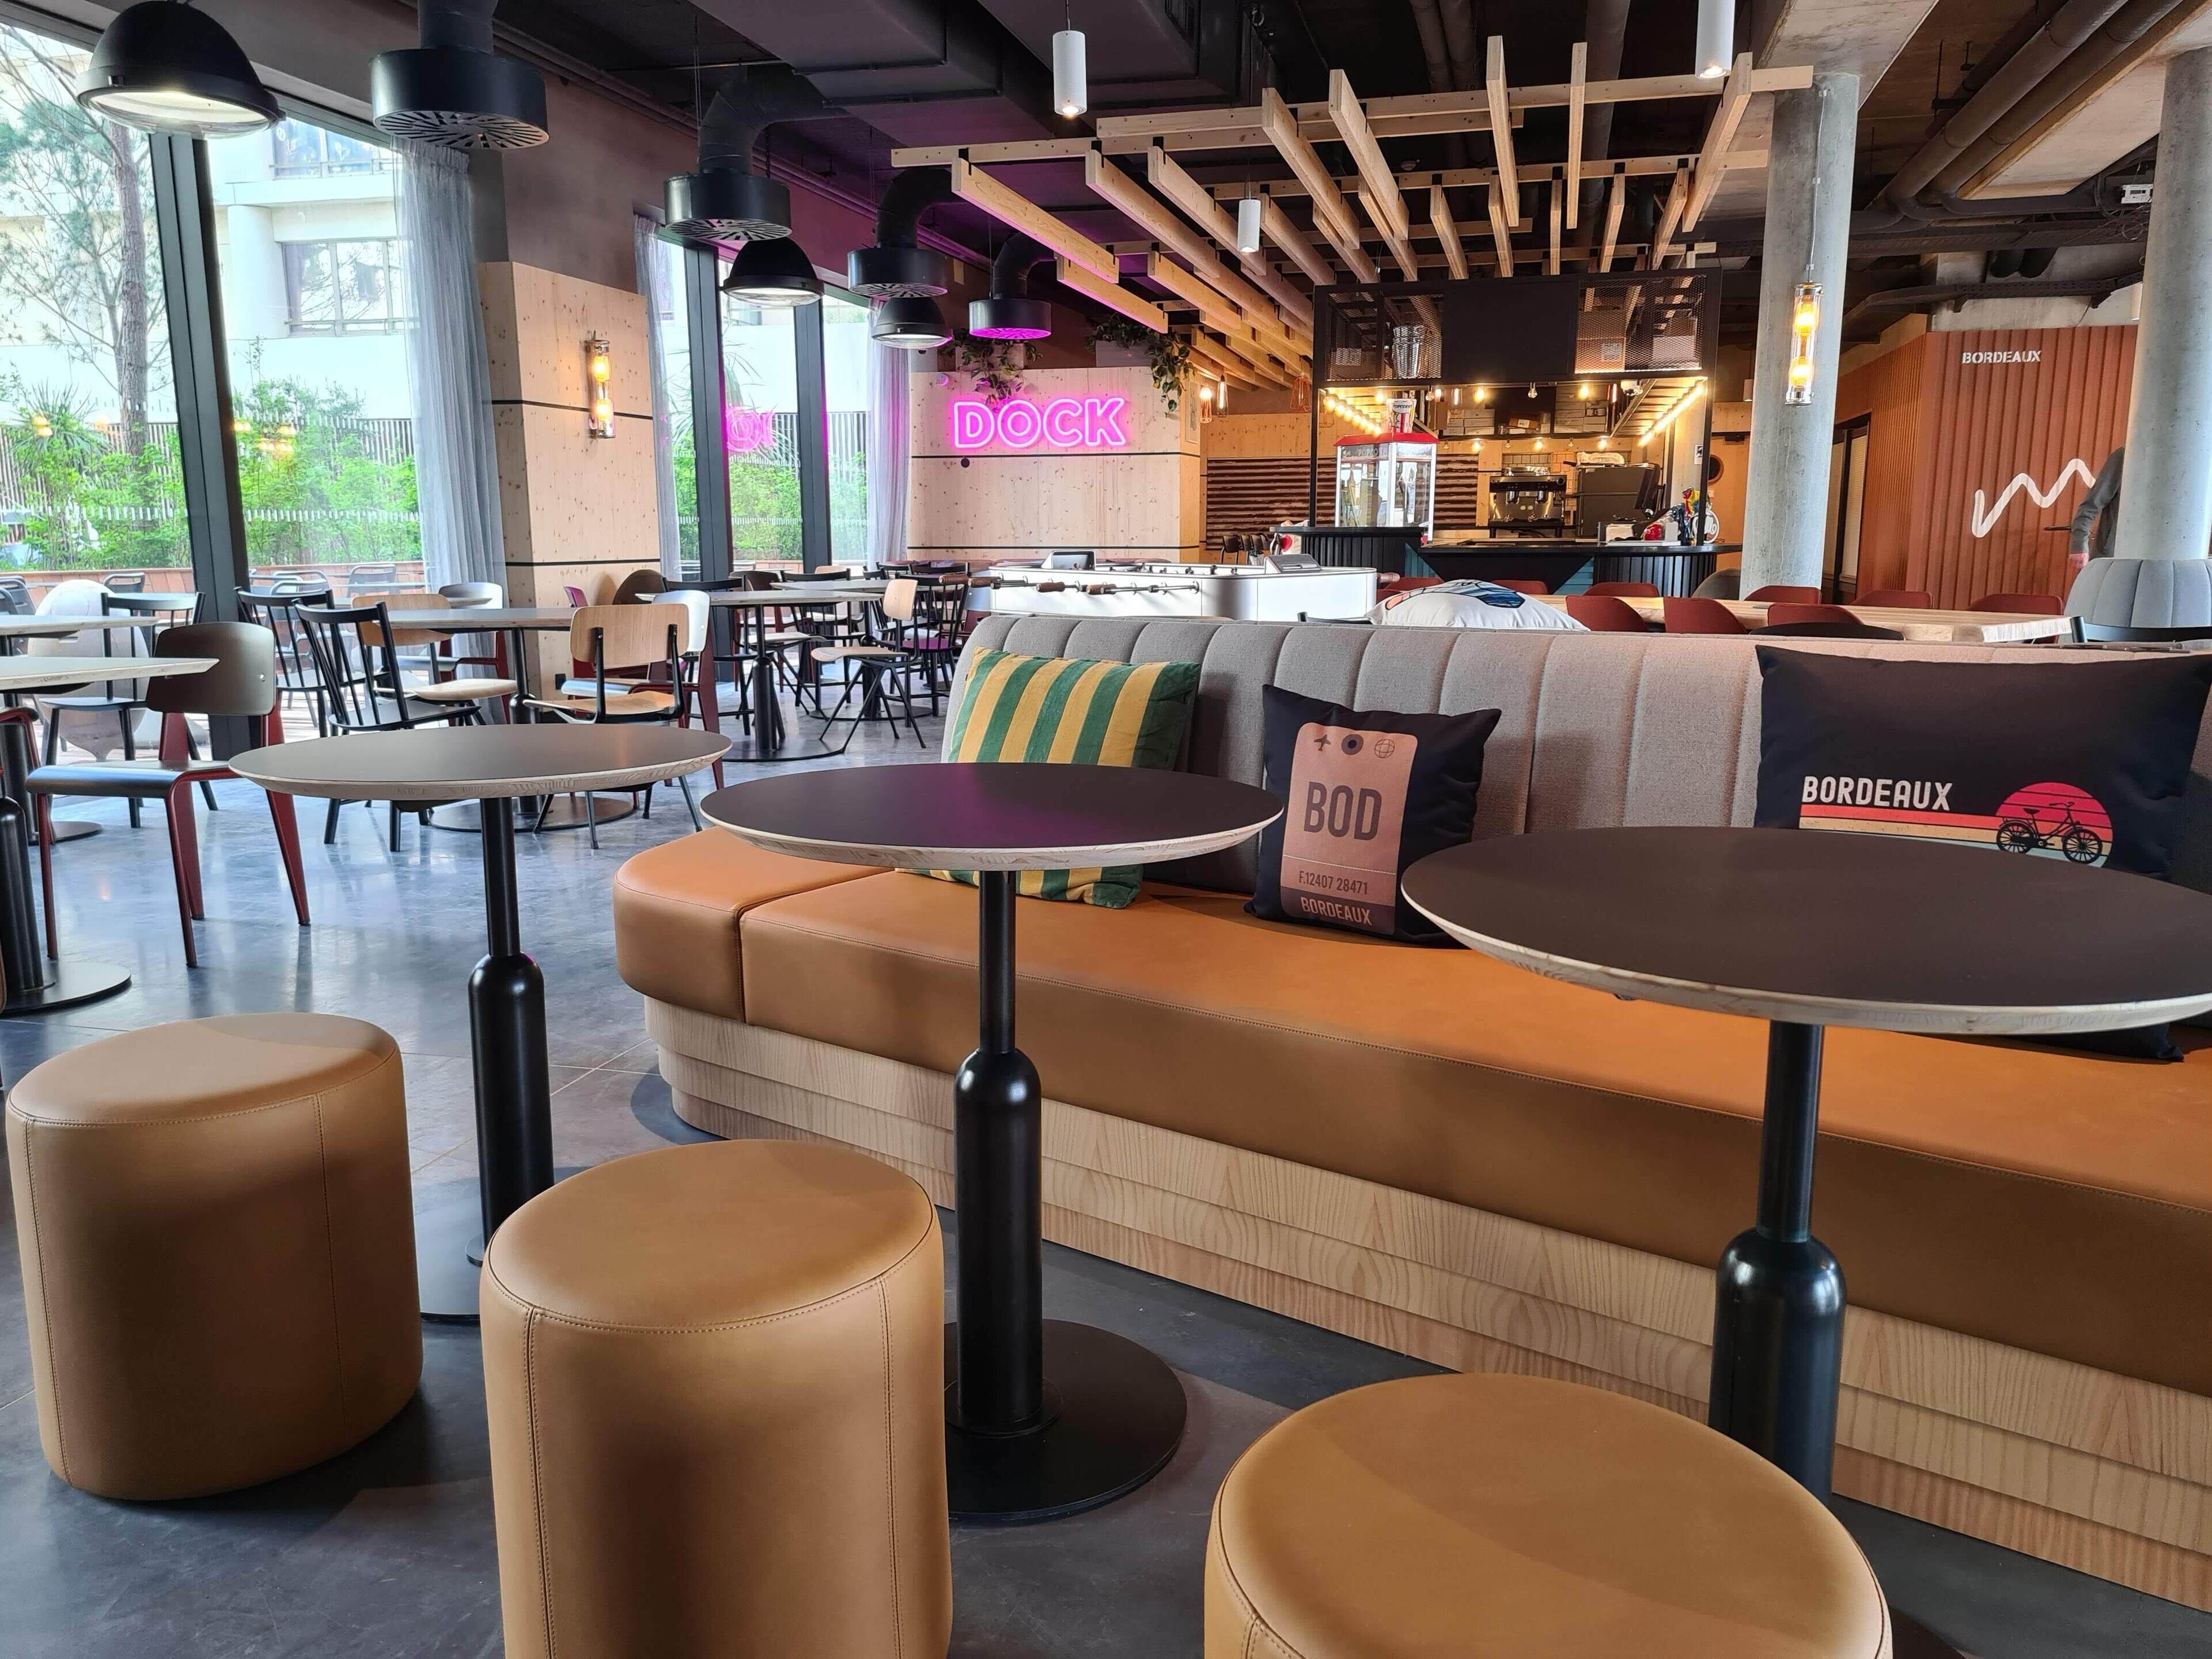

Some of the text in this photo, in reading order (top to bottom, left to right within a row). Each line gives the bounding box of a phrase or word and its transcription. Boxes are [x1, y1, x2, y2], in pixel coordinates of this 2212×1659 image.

[1961, 350, 2041, 364] BORDEAUX
[954, 397, 1127, 449] DOCK
[1802, 776, 1953, 811] BORDEAUX
[1304, 782, 1382, 840] BOD
[1300, 871, 1368, 895] F.12407 28471
[1301, 896, 1372, 926] BORDEAUX
